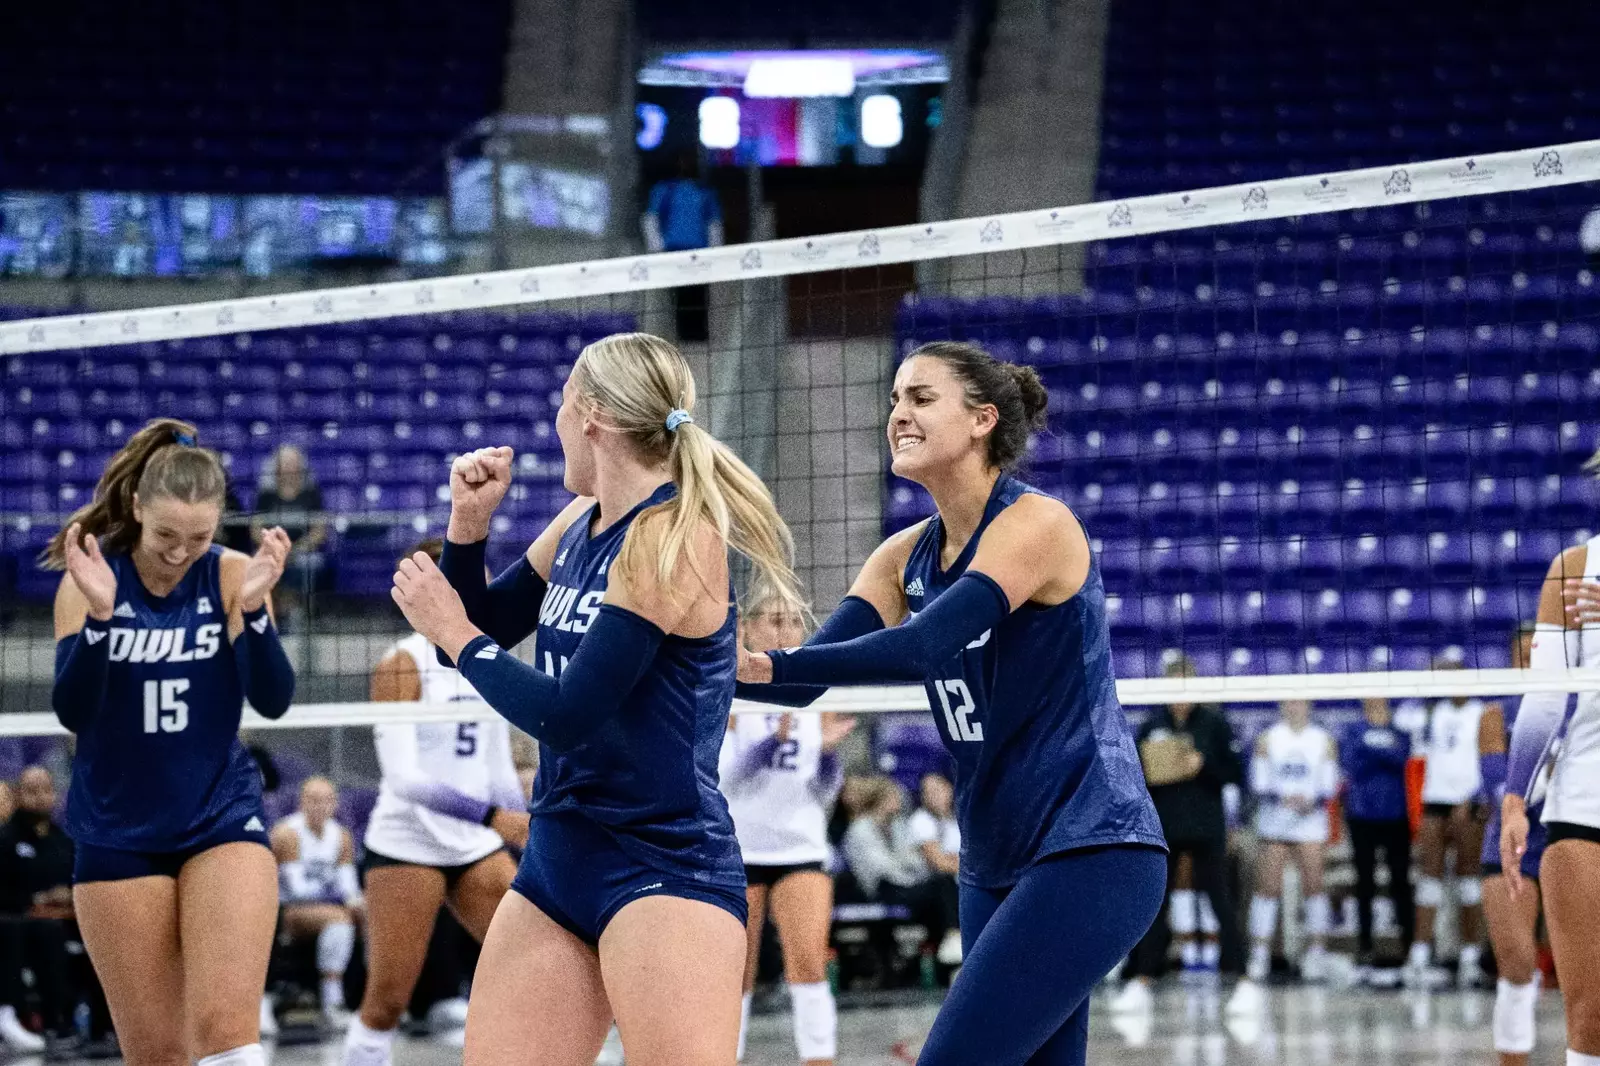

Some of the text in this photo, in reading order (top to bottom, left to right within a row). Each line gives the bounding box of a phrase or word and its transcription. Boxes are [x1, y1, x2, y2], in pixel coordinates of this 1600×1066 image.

[538, 582, 606, 633] WLS
[107, 623, 223, 663] OWLS
[143, 678, 190, 733] 15
[934, 679, 984, 742] 12
[455, 721, 478, 757] 5
